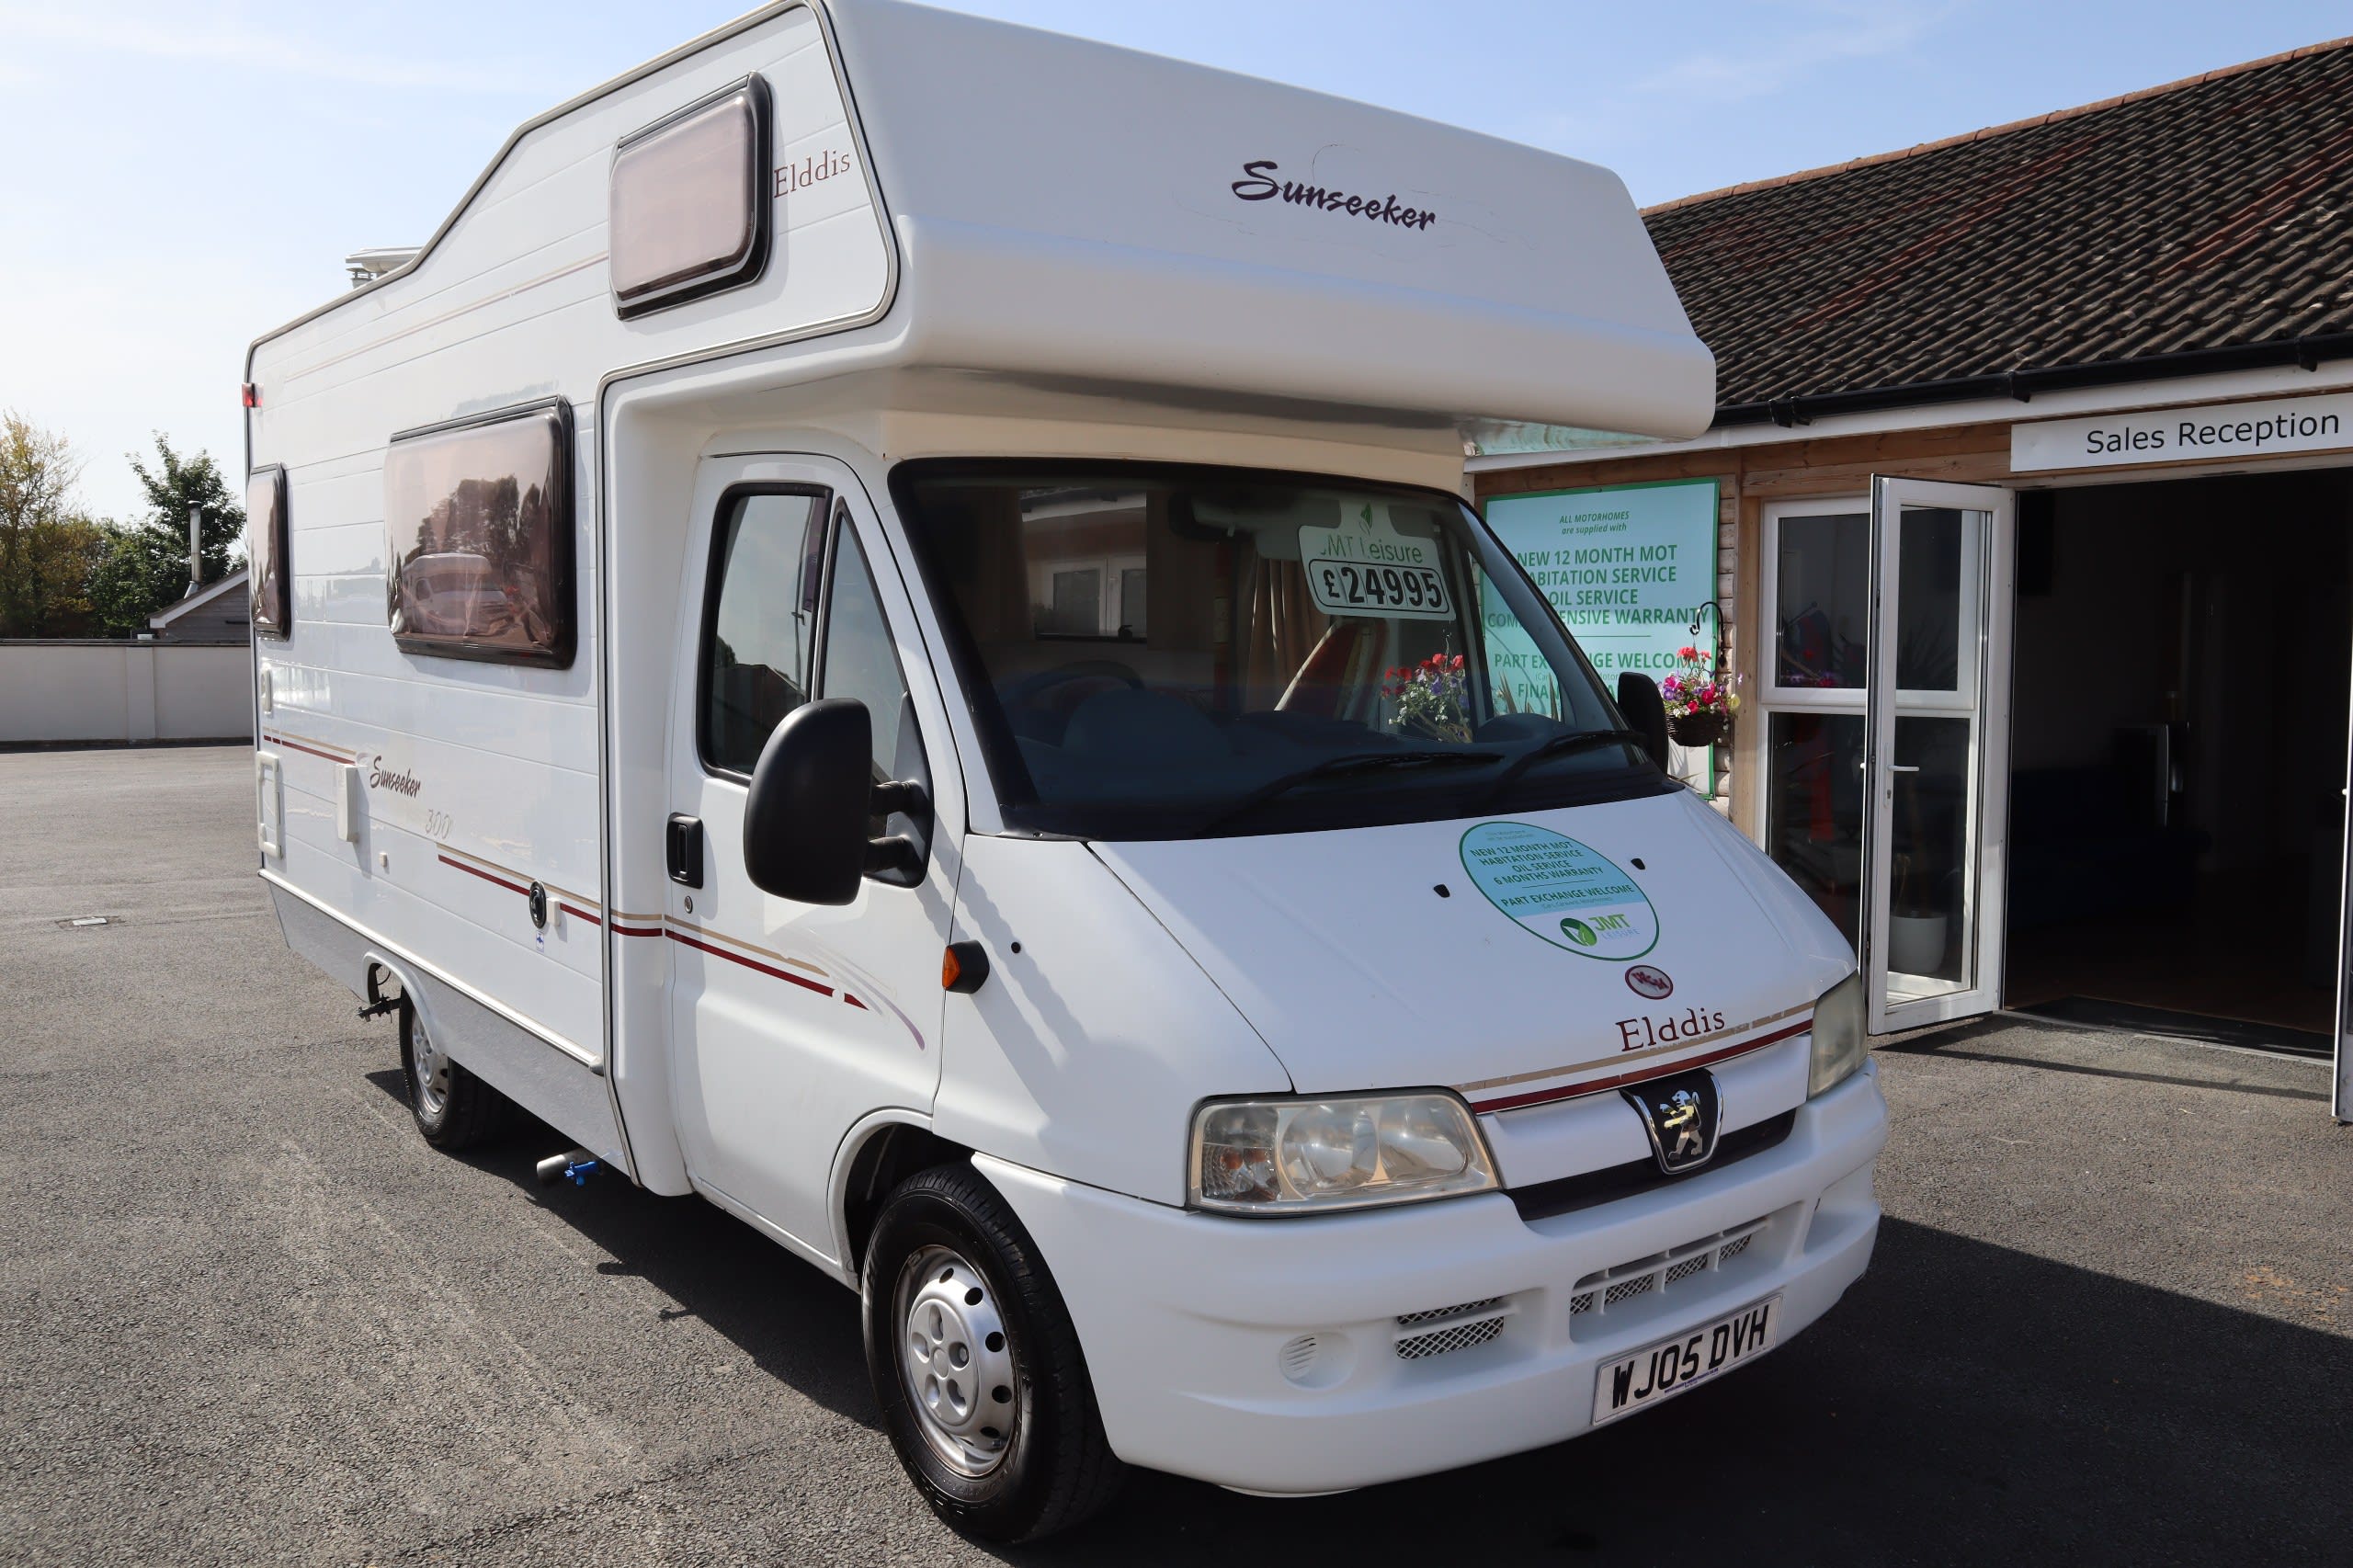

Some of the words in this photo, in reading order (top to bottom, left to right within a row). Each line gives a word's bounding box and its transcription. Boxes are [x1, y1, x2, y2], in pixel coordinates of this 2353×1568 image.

[773, 150, 850, 199] Elddis
[1231, 160, 1436, 231] Sunseeker
[2086, 426, 2165, 454] Sales
[2178, 412, 2339, 447] Reception
[1560, 515, 1573, 524] ALL
[1574, 511, 1630, 523] MOTORHOMES
[1575, 524, 1608, 536] supplied
[1609, 522, 1627, 532] with
[1517, 551, 1550, 566] NEW
[1554, 551, 1570, 564] 12
[1574, 547, 1634, 564] MONTH
[1640, 544, 1677, 562] MOT
[1529, 568, 1607, 586] ABITATION
[1611, 566, 1677, 584] SERVICE
[1323, 566, 1442, 608] £24995
[1549, 591, 1572, 606] OIL
[1575, 589, 1638, 606] SERVICE
[1615, 608, 1709, 624] WARRANTY
[1495, 653, 1528, 667] PART
[369, 755, 421, 799] Sunseeker
[1471, 847, 1496, 857] NEW
[1511, 844, 1551, 853] MONTH
[1550, 841, 1574, 850] MOT
[1479, 853, 1543, 866] HABITATION
[1543, 849, 1584, 860] SERVICE
[1531, 860, 1573, 870] SERVICE
[1494, 877, 1503, 885] 6
[1502, 871, 1549, 883] MONTHS
[1548, 867, 1604, 879] WARRANTY
[1501, 896, 1529, 906] PART
[1529, 890, 1586, 903] EXCHANGE
[1587, 884, 1635, 896] WELCOME
[1588, 914, 1631, 931] JMT
[1615, 1007, 1725, 1051] Elddis
[1708, 1305, 1769, 1369] DVH
